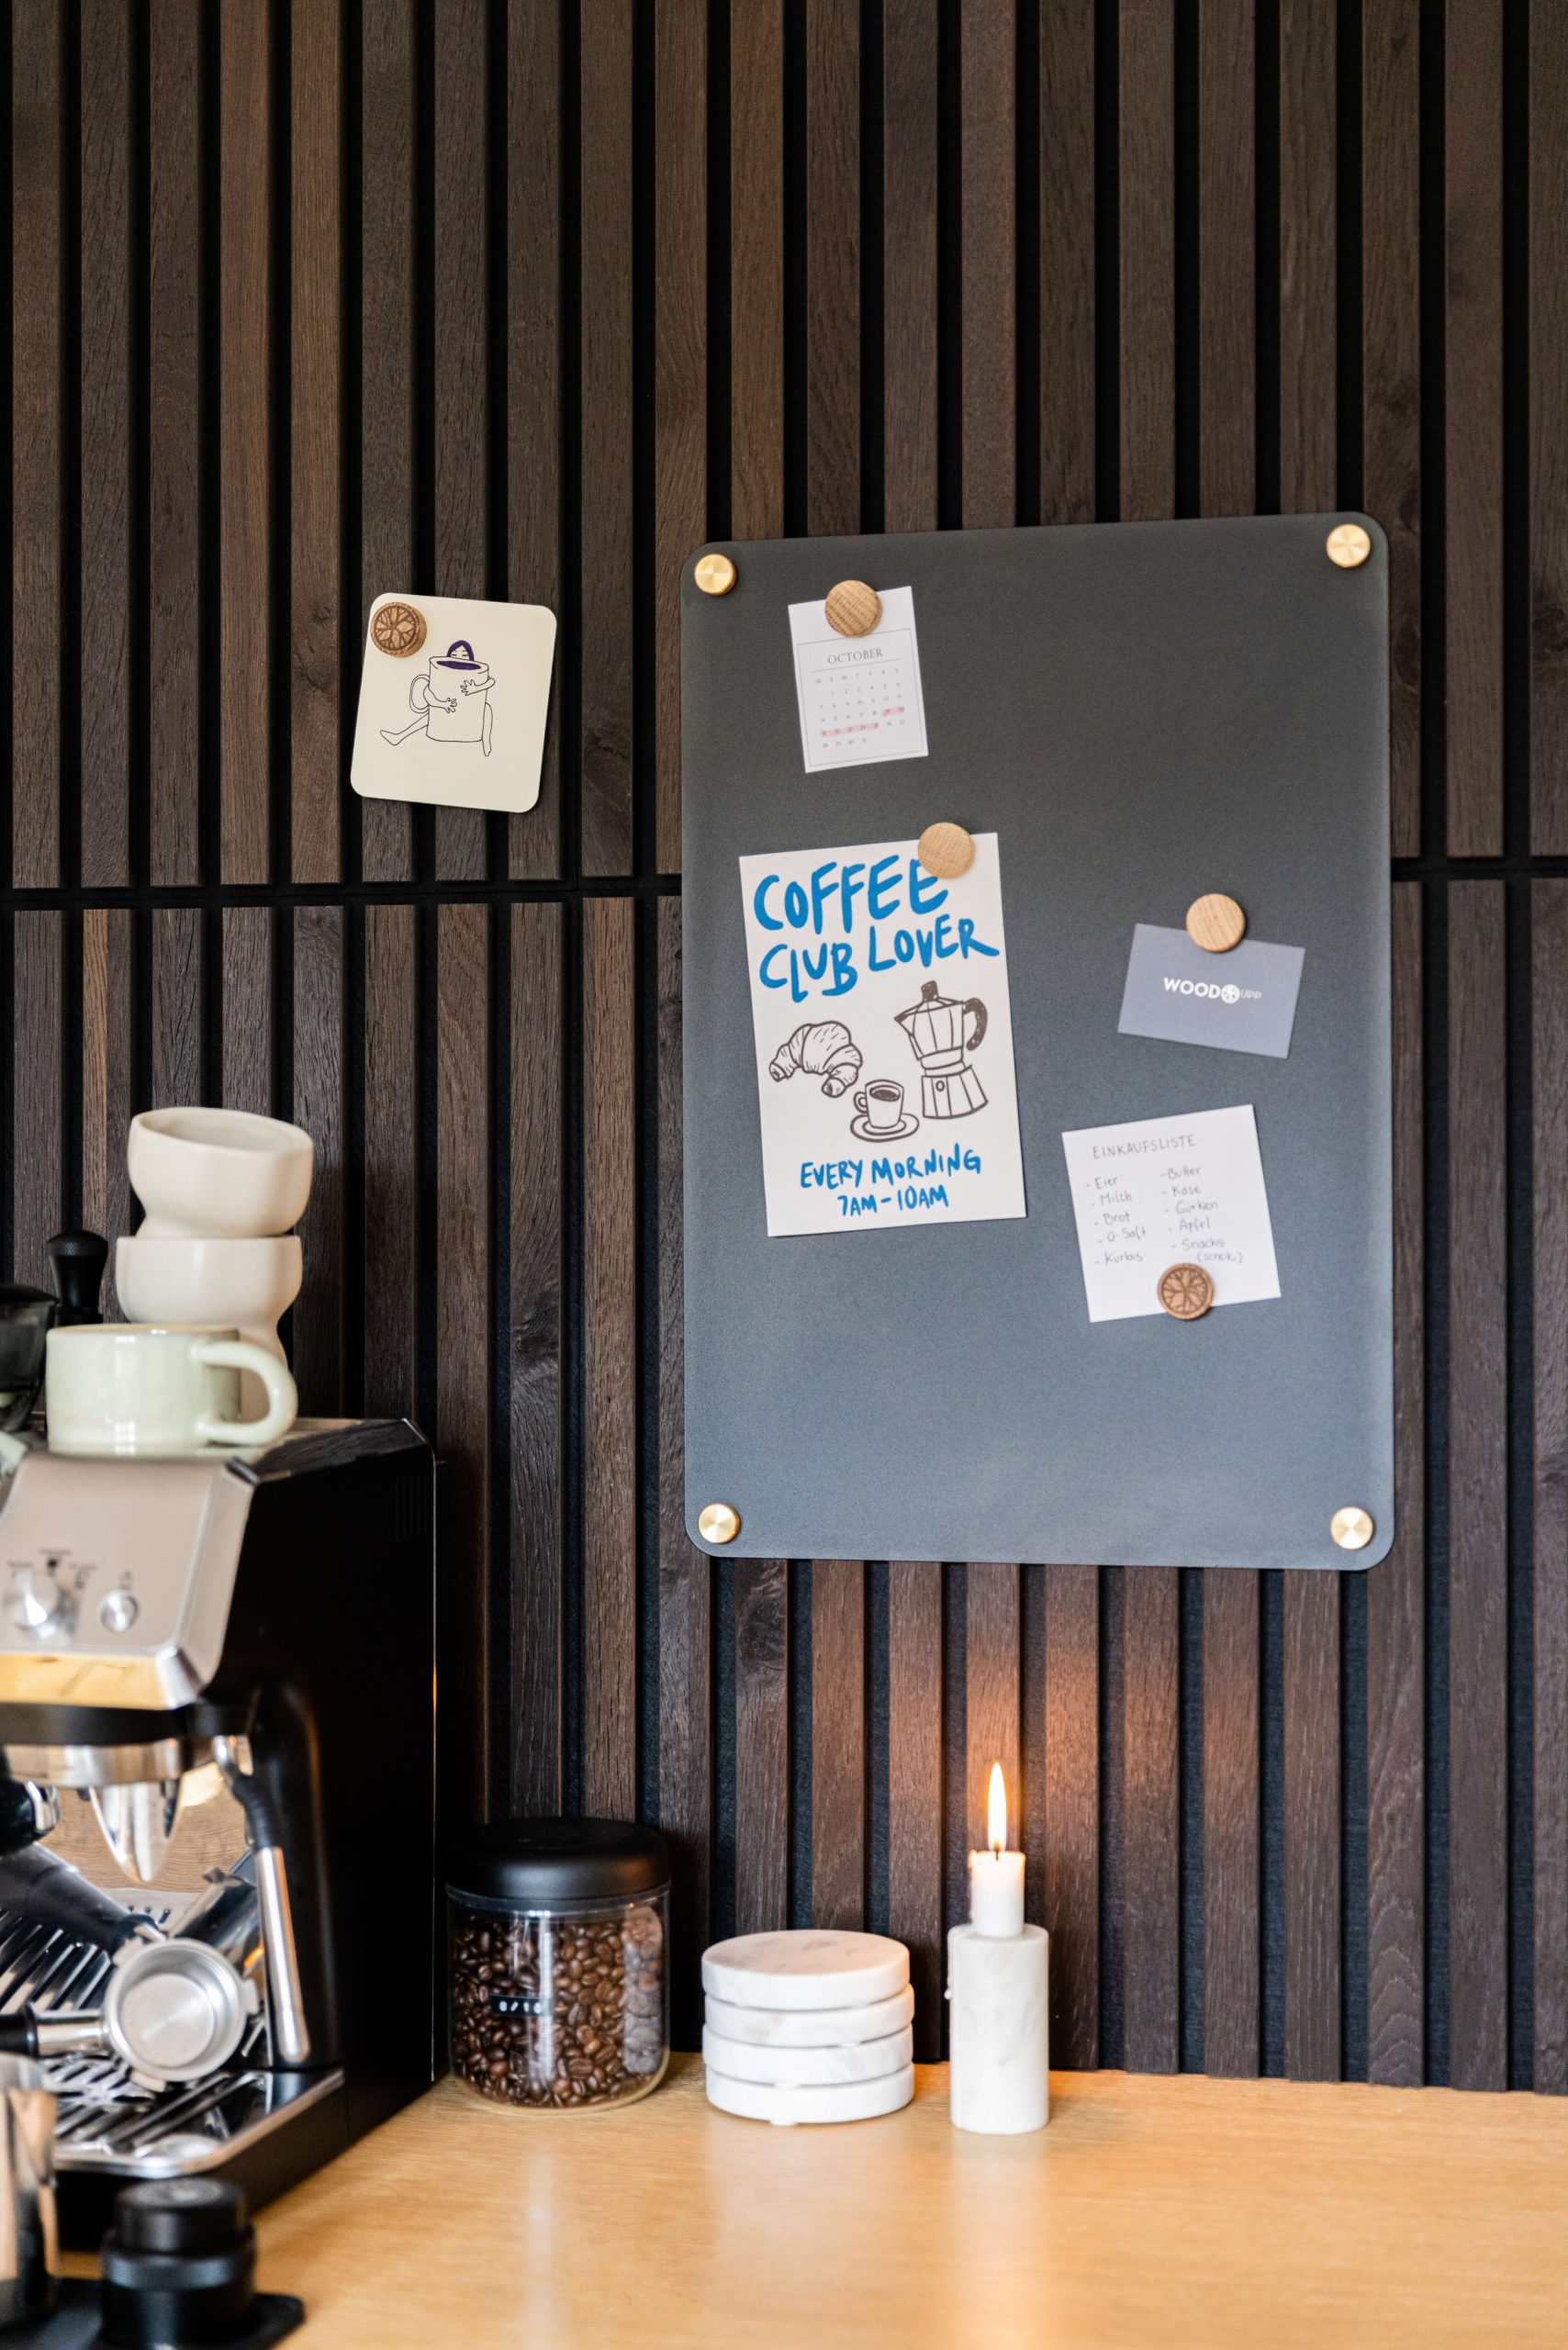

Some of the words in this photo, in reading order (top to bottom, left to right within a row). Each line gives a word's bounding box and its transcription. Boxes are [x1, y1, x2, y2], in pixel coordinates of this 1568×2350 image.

[827, 648, 883, 665] OCTOBER
[754, 855, 949, 935] COFFEE
[759, 943, 858, 1003] CLUB
[868, 913, 1000, 972] LOVER
[1163, 977, 1221, 999] WOOD
[1092, 1134, 1197, 1159] EINKAUFSLISTE
[801, 1159, 863, 1190] EVERY
[871, 1143, 981, 1186] MORNING
[1094, 1176, 1118, 1190] Eier
[1100, 1192, 1133, 1207] Milch
[1175, 1200, 1219, 1214] Gurken
[1103, 1211, 1130, 1226] Brot
